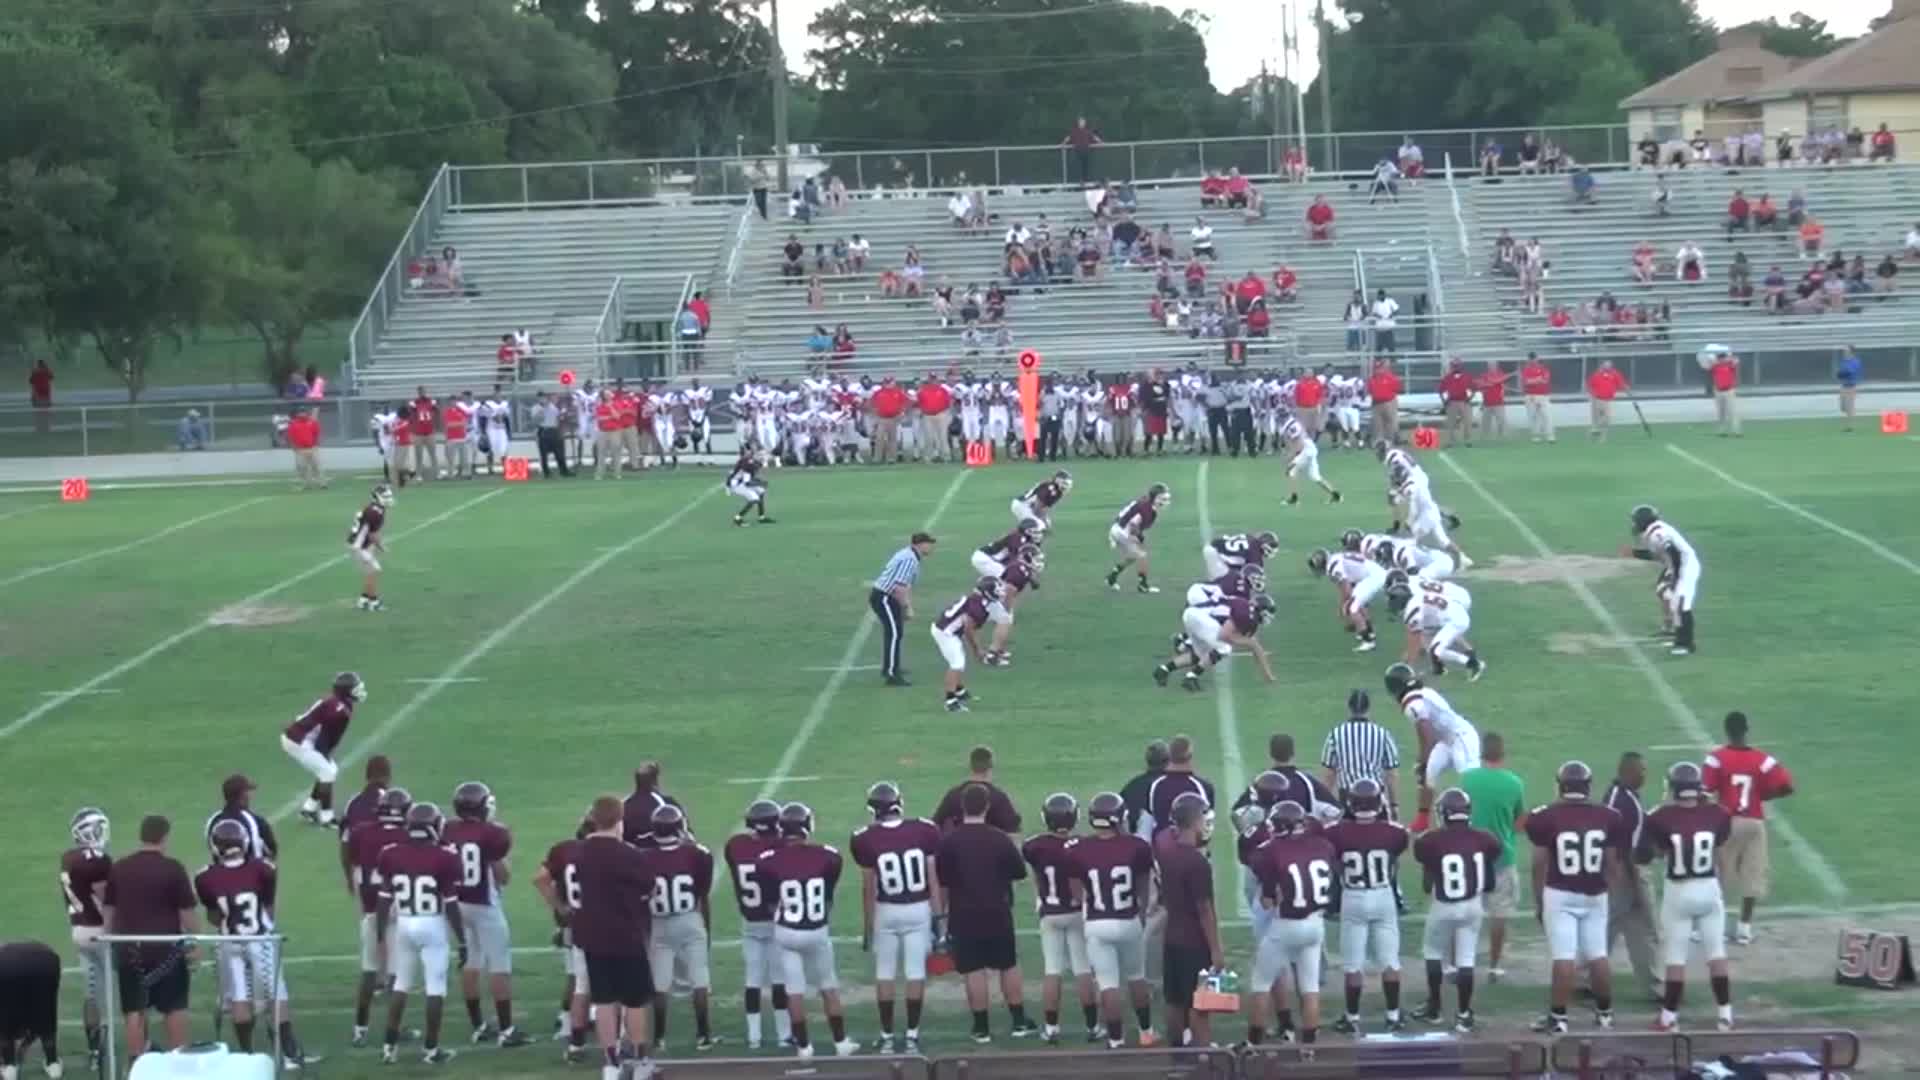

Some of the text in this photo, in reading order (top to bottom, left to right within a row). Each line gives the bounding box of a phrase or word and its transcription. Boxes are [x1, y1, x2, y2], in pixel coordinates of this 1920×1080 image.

[968, 441, 986, 460] 40
[65, 479, 84, 497] 20
[1731, 774, 1752, 811] 7
[877, 849, 925, 895] 80
[1342, 849, 1390, 888] 20
[1556, 830, 1606, 875] 66
[1670, 831, 1715, 875] 18
[391, 873, 437, 915] 26
[738, 864, 762, 907] 5
[1044, 866, 1060, 905] 1
[1087, 866, 1133, 910] 12
[1441, 852, 1484, 898] 81
[216, 892, 260, 935] 13
[1839, 932, 1902, 981] 50
